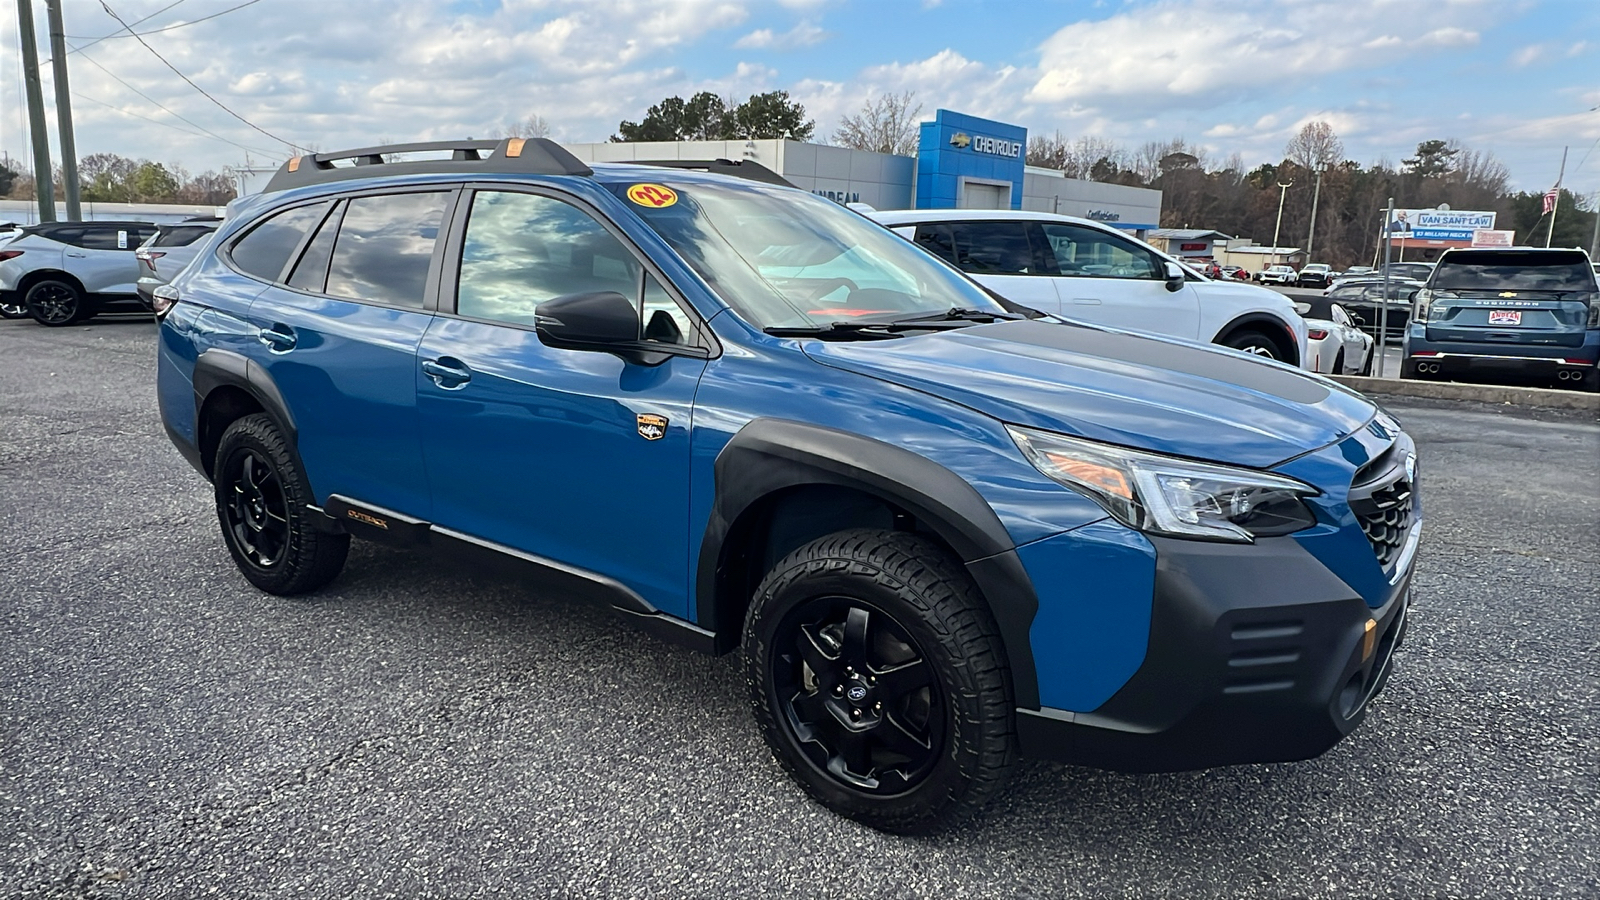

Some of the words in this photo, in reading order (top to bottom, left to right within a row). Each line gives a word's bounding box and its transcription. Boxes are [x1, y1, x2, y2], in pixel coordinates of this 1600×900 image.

[974, 136, 1022, 158] CHEVROLET
[635, 185, 673, 207] 22
[1422, 216, 1441, 224] VAN
[1442, 216, 1468, 225] SANT
[1468, 217, 1489, 226] LAW
[1490, 312, 1520, 320] ANDEAN
